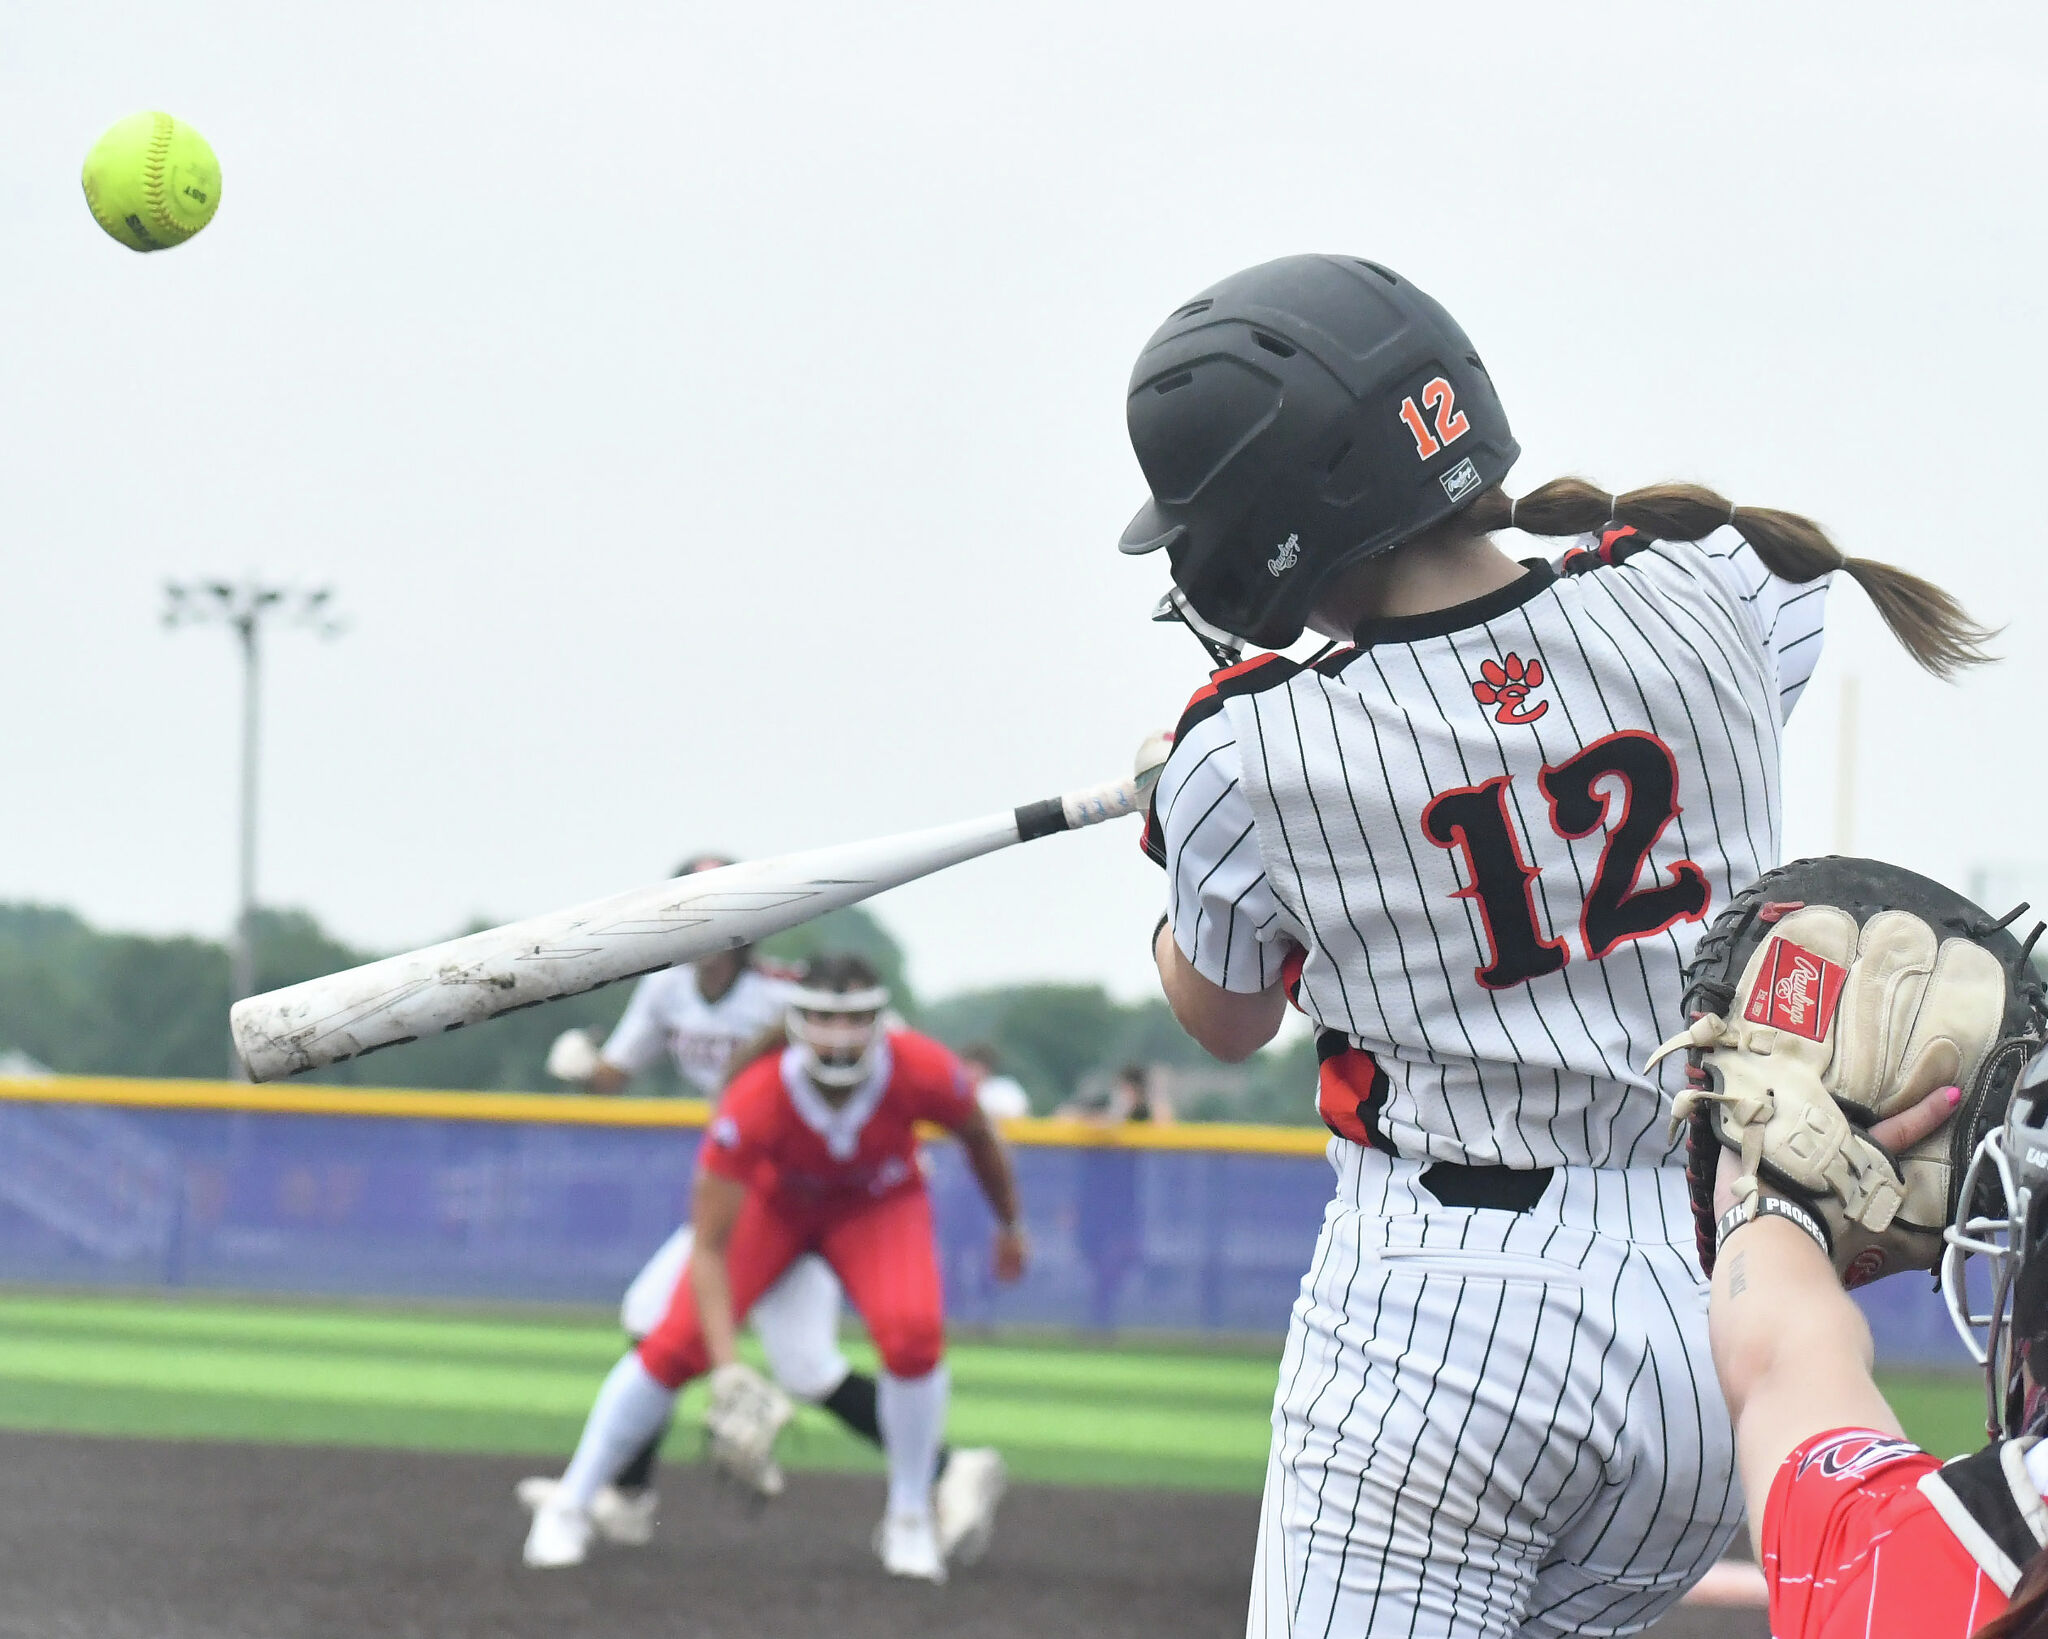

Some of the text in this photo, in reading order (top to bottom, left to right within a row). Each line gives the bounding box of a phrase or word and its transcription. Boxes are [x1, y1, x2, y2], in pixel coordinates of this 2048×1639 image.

[1399, 377, 1470, 460] 12
[1268, 533, 1300, 577] Rawlings
[1421, 729, 1711, 990] 12
[1778, 956, 1818, 1024] Rawlings
[2025, 1147, 2048, 1169] EAS
[1725, 1203, 1748, 1228] TH
